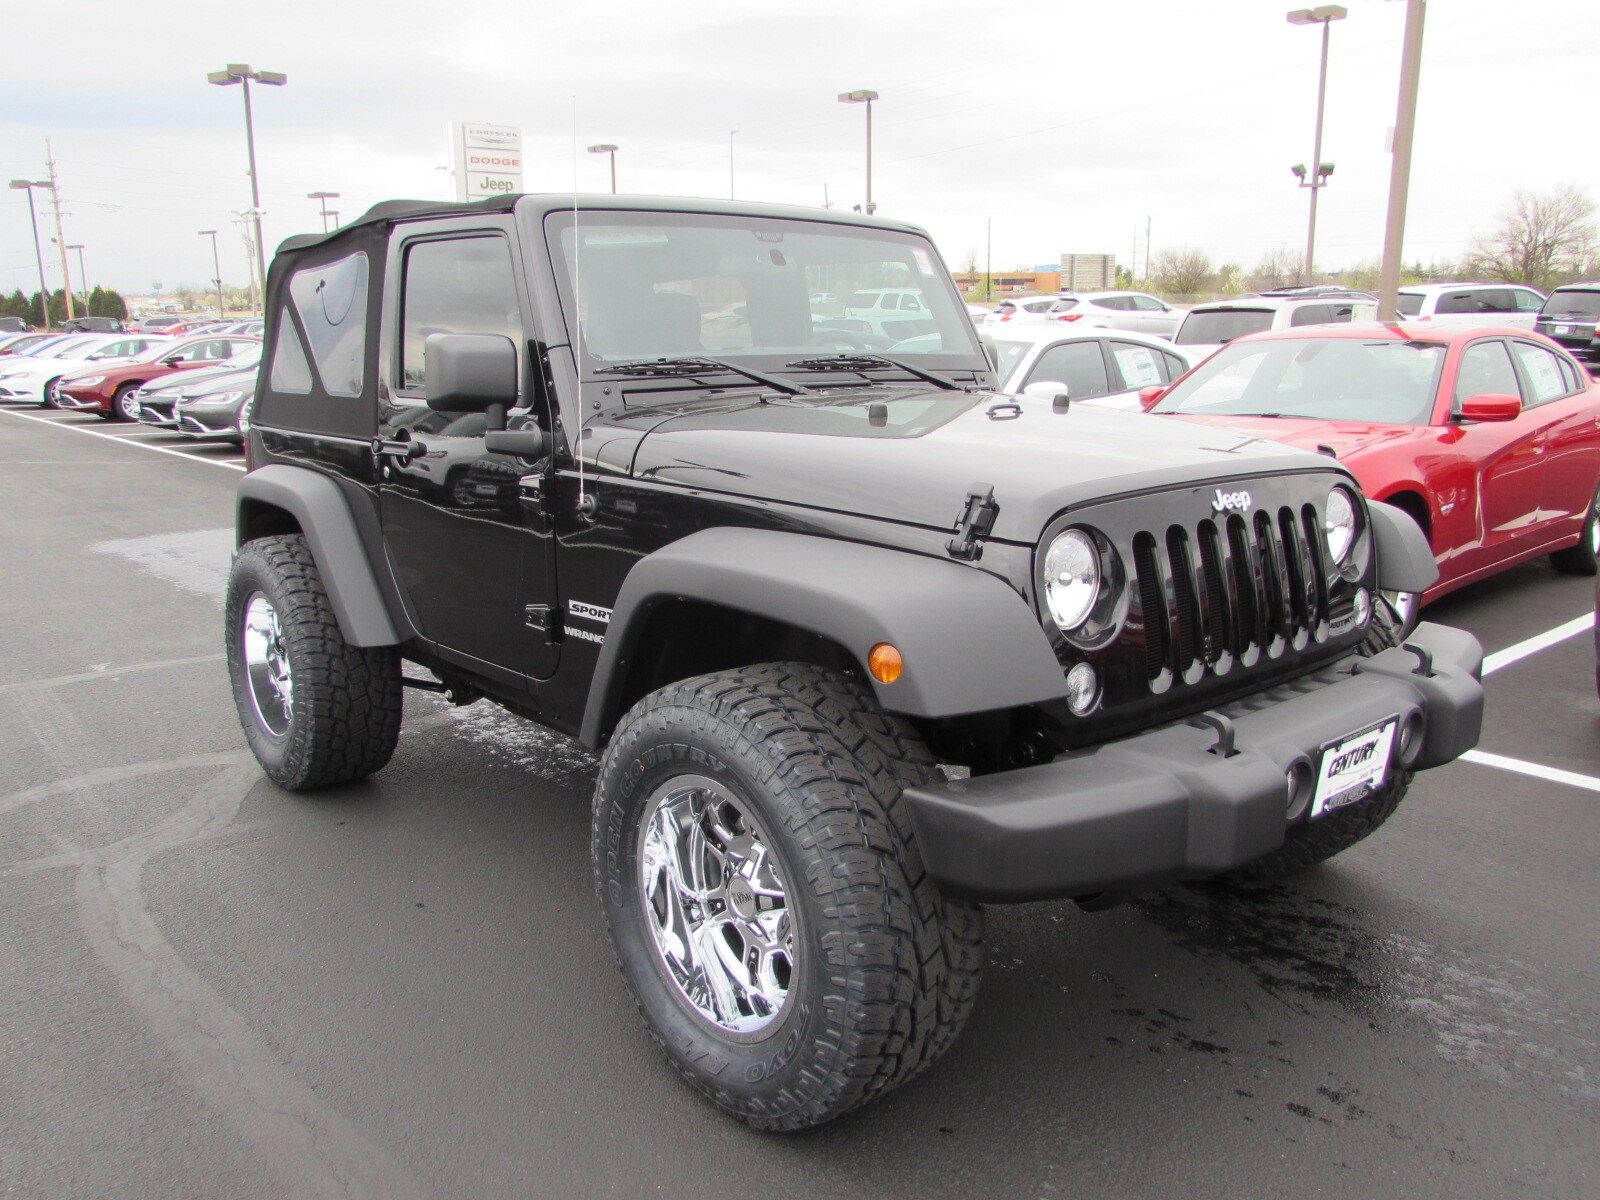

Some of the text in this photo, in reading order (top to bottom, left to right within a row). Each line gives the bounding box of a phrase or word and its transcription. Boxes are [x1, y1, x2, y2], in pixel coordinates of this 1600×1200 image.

[470, 157, 520, 166] DODGE
[480, 177, 513, 193] Jeep
[1212, 489, 1251, 511] Jeep
[564, 626, 605, 644] WRANG
[1328, 739, 1379, 778] CENTURY
[607, 743, 727, 908] OPEN COUNTRY
